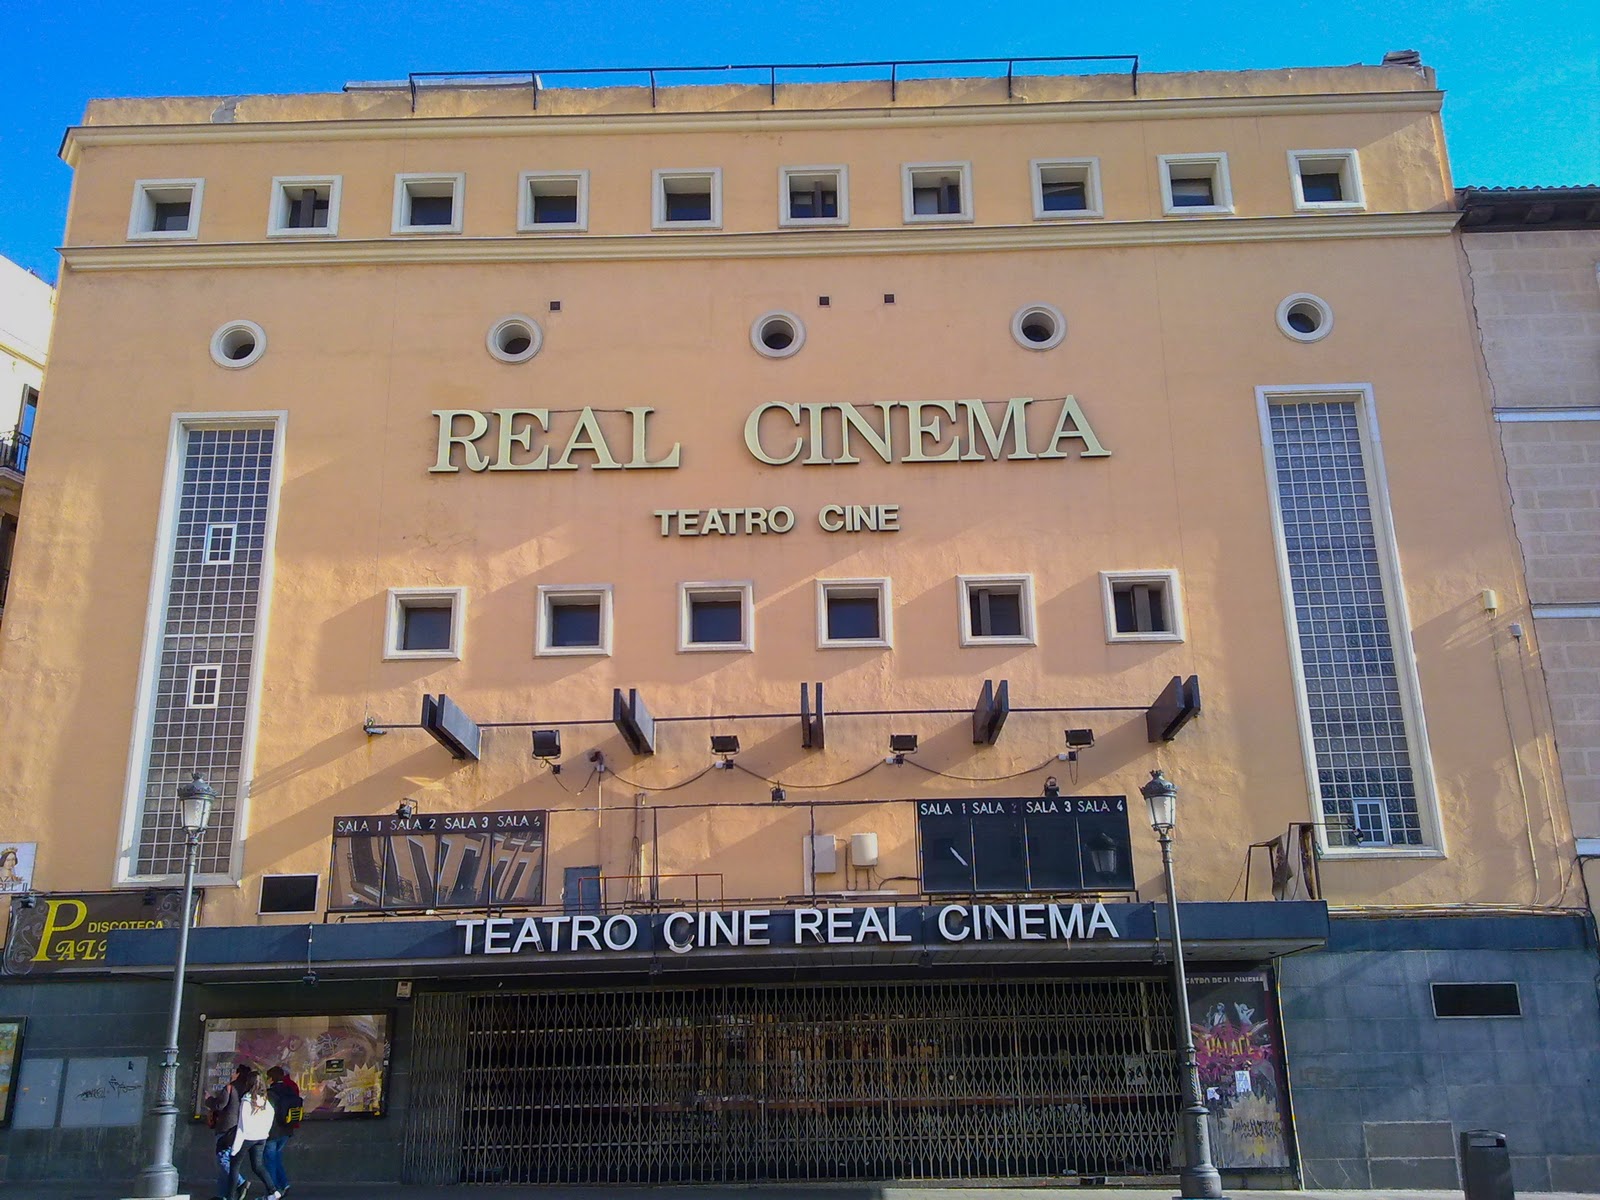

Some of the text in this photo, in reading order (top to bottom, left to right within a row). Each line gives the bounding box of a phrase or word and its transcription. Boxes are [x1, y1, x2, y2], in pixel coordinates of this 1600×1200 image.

[428, 394, 1112, 473] REAL CINEMA
[654, 504, 901, 536] TEATRO CINE
[920, 802, 952, 816] SALA
[961, 803, 967, 815] 1
[972, 802, 1005, 815] SALA
[1026, 801, 1059, 814] SALA
[1064, 800, 1072, 812] 3
[1077, 800, 1110, 813] SALA
[1116, 799, 1123, 812] 4
[337, 820, 370, 833] SALA
[377, 820, 382, 832] 1
[389, 818, 422, 831] SALA
[428, 818, 436, 830] 2
[444, 817, 477, 830] SALA
[481, 816, 489, 829] 3
[496, 815, 529, 828] SALA
[88, 920, 164, 933] DISCOTECA
[455, 903, 1120, 955] TEATRO CINE REAL CINEMA
